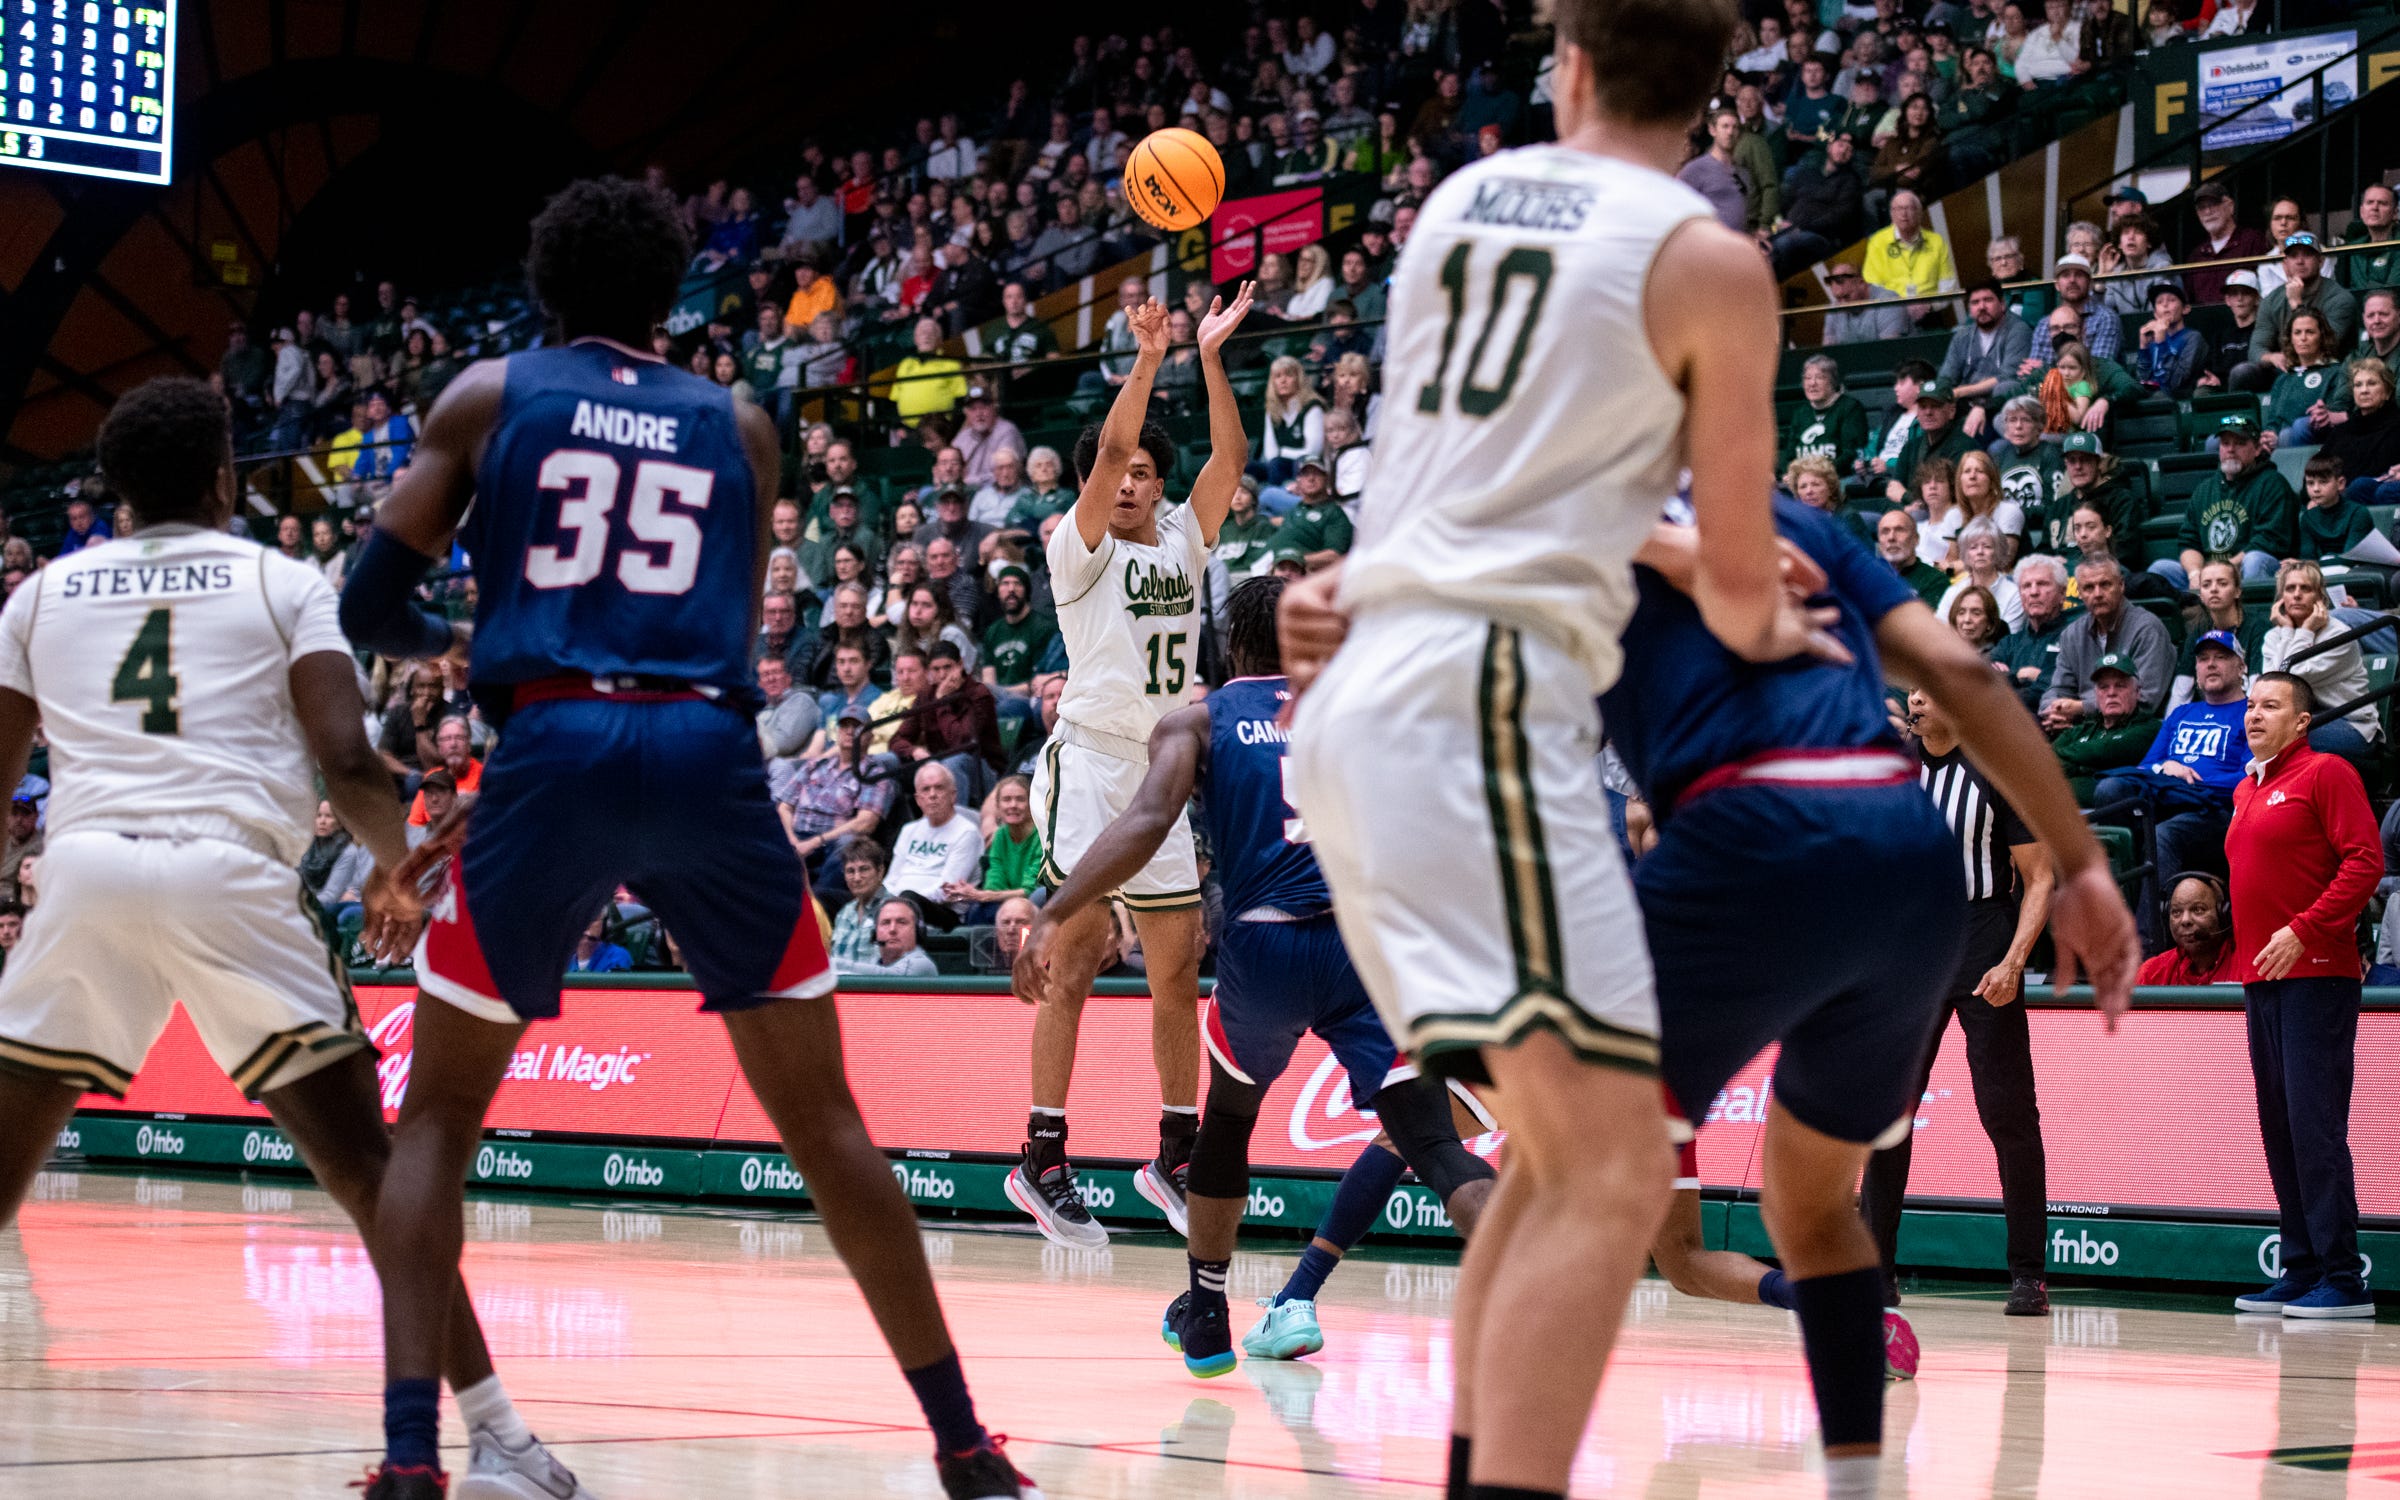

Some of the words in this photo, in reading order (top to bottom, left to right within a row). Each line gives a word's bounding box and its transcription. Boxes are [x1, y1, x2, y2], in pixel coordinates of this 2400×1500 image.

[84, 2, 99, 24] 0
[114, 7, 130, 29] 0
[20, 20, 37, 41] 4
[52, 24, 66, 46] 3
[83, 28, 97, 50] 3
[113, 33, 129, 55] 0
[145, 26, 158, 46] 2
[20, 46, 35, 68] 2
[51, 50, 63, 72] 1
[82, 54, 96, 76] 2
[112, 59, 125, 81] 1
[144, 69, 157, 89] 3
[19, 72, 35, 94] 0
[51, 76, 63, 98] 1
[81, 81, 97, 103] 0
[111, 85, 124, 107] 1
[18, 99, 34, 121] 0
[49, 103, 64, 125] 2
[80, 107, 96, 129] 0
[110, 111, 127, 133] 0
[2155, 81, 2188, 135] F
[28, 135, 45, 159] 3
[1416, 239, 1556, 417] 10
[570, 399, 680, 454] ANDRE
[524, 448, 715, 596] 35
[63, 564, 232, 599] STEVENS
[111, 602, 182, 735] 4
[1145, 632, 1187, 696] 15
[1236, 719, 1293, 746] CAM
[2174, 726, 2223, 757] 970
[548, 1045, 642, 1091] Magic
[152, 1129, 184, 1155] fnbo
[261, 1136, 293, 1161] fnbo
[496, 1151, 532, 1177] fnbo
[625, 1157, 663, 1186] fnbo
[763, 1162, 804, 1190] fnbo
[911, 1168, 955, 1199] fnbo
[1416, 1196, 1454, 1228] fnb
[2051, 1228, 2119, 1266] fnbo
